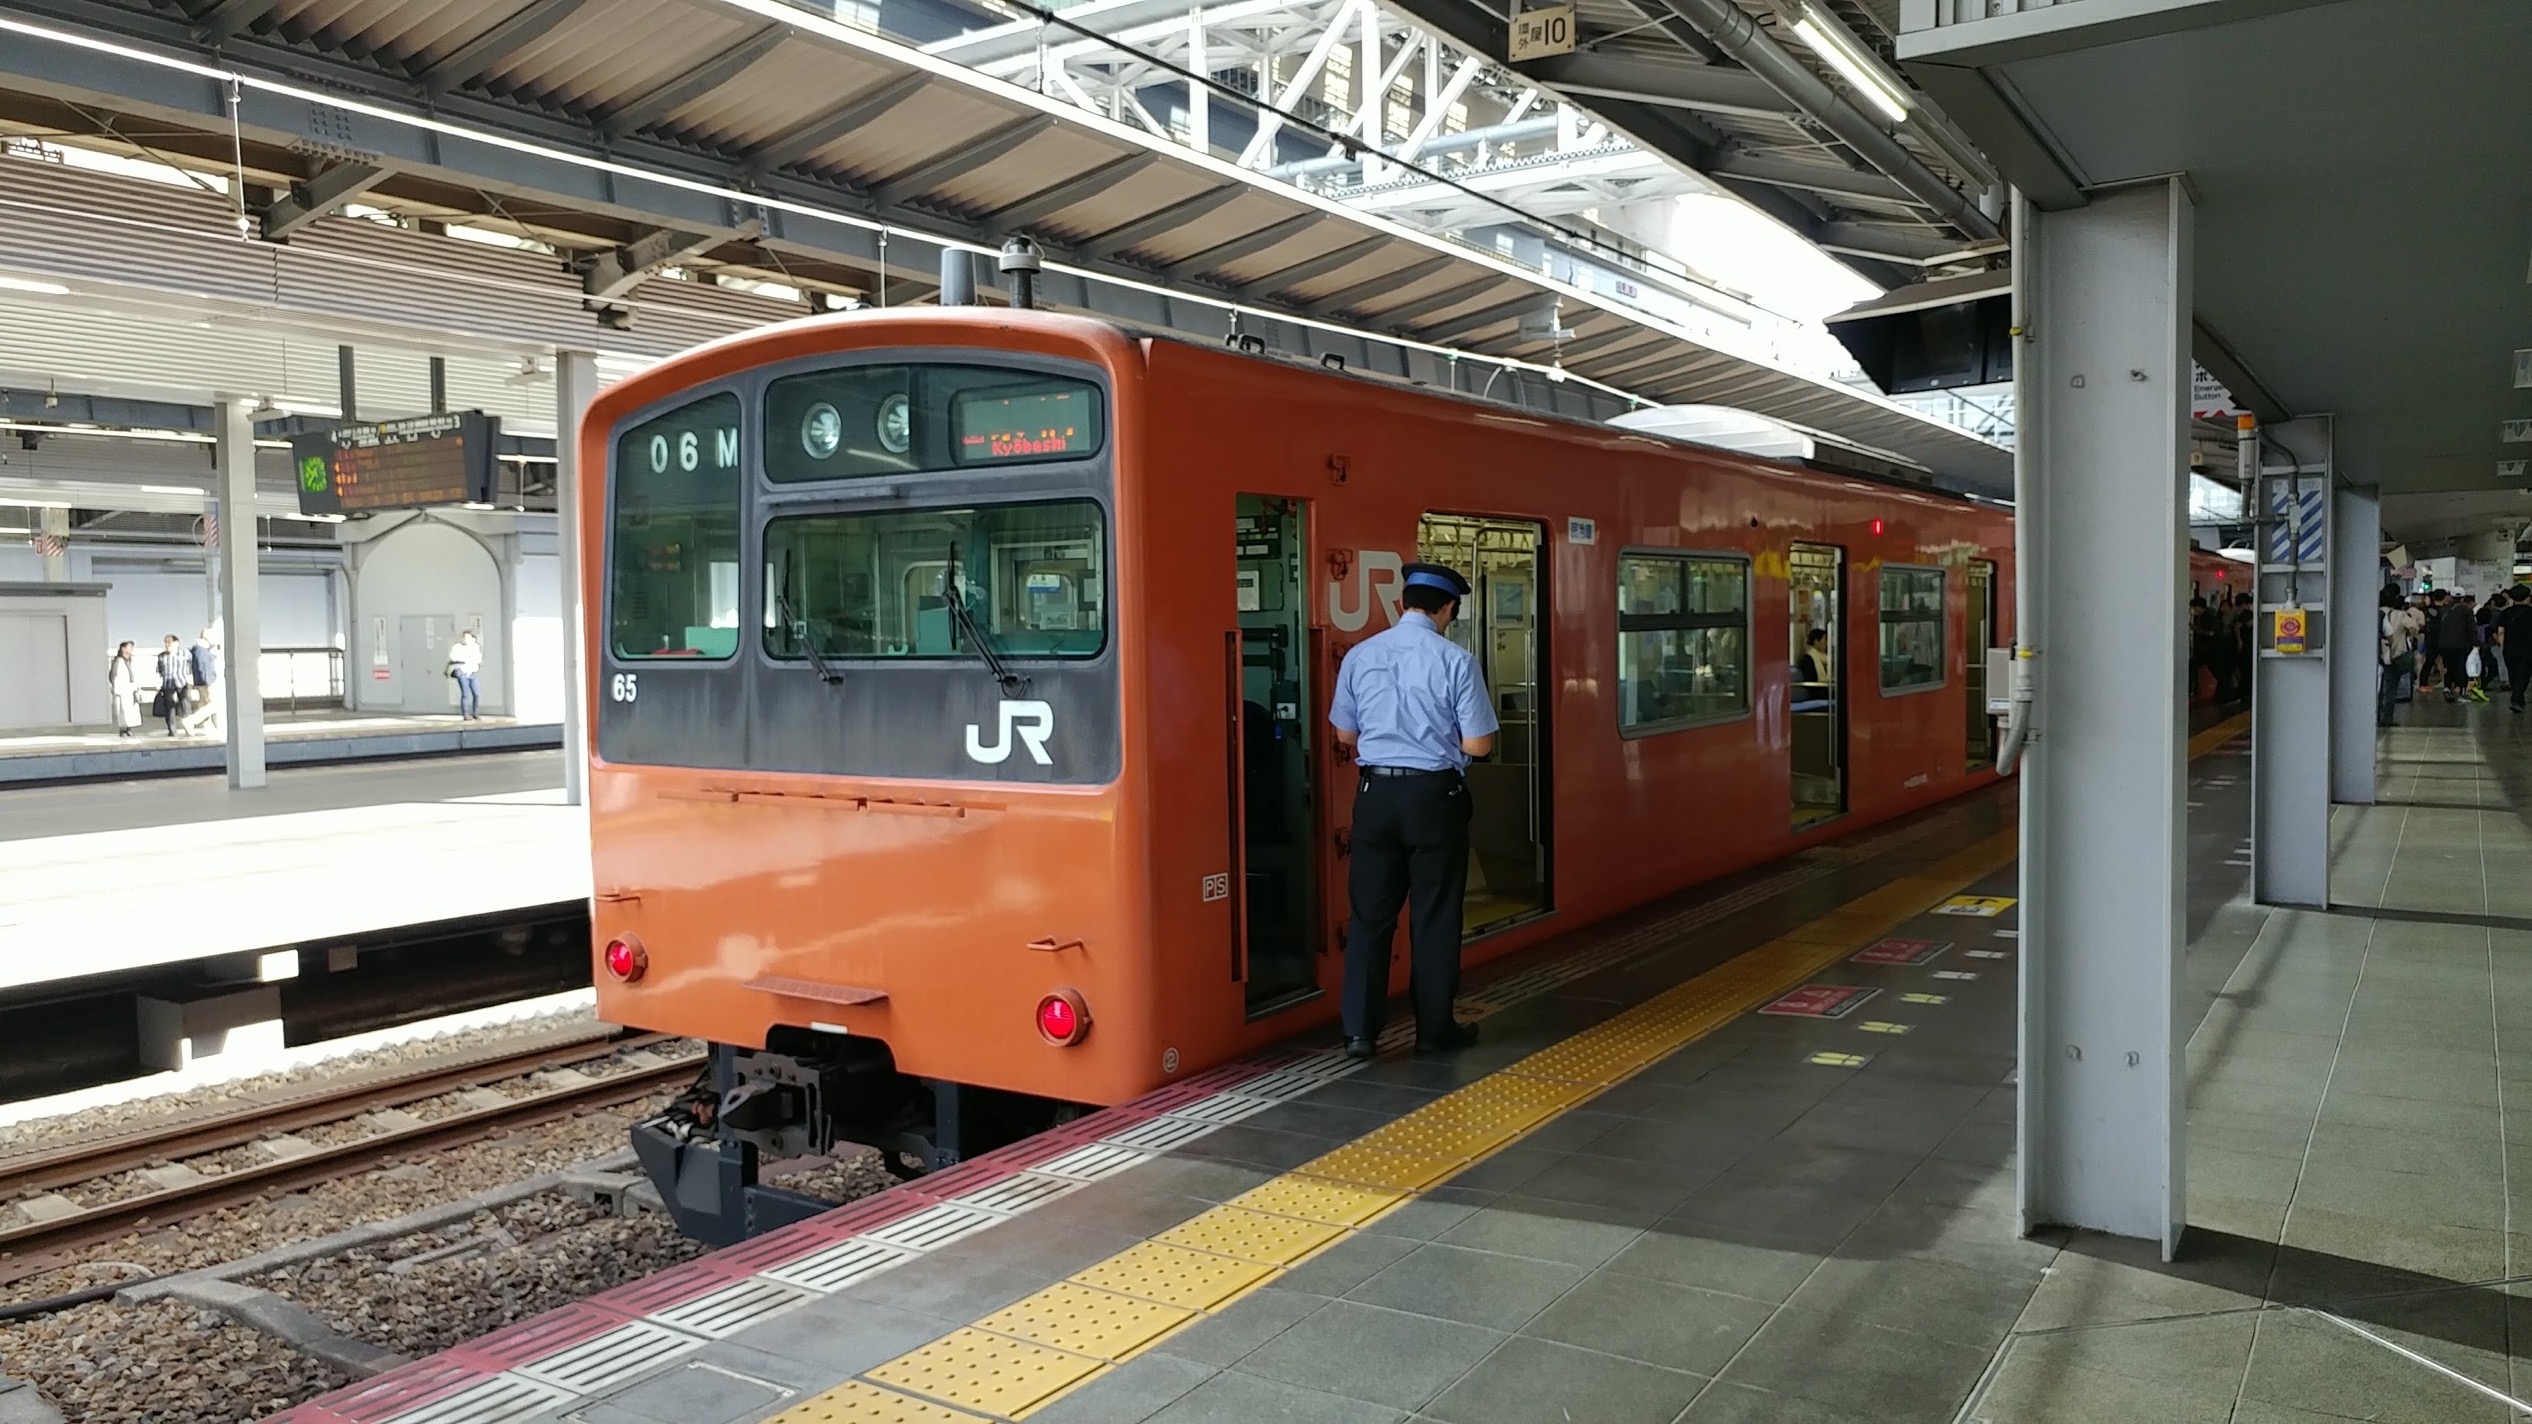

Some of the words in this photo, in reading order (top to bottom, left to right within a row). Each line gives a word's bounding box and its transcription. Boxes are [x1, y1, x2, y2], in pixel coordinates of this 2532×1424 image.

[1544, 17, 1566, 46] 10
[1330, 550, 1404, 632] JR
[612, 673, 638, 703] 65
[966, 700, 1054, 765] JR
[1206, 877, 1226, 898] PS
